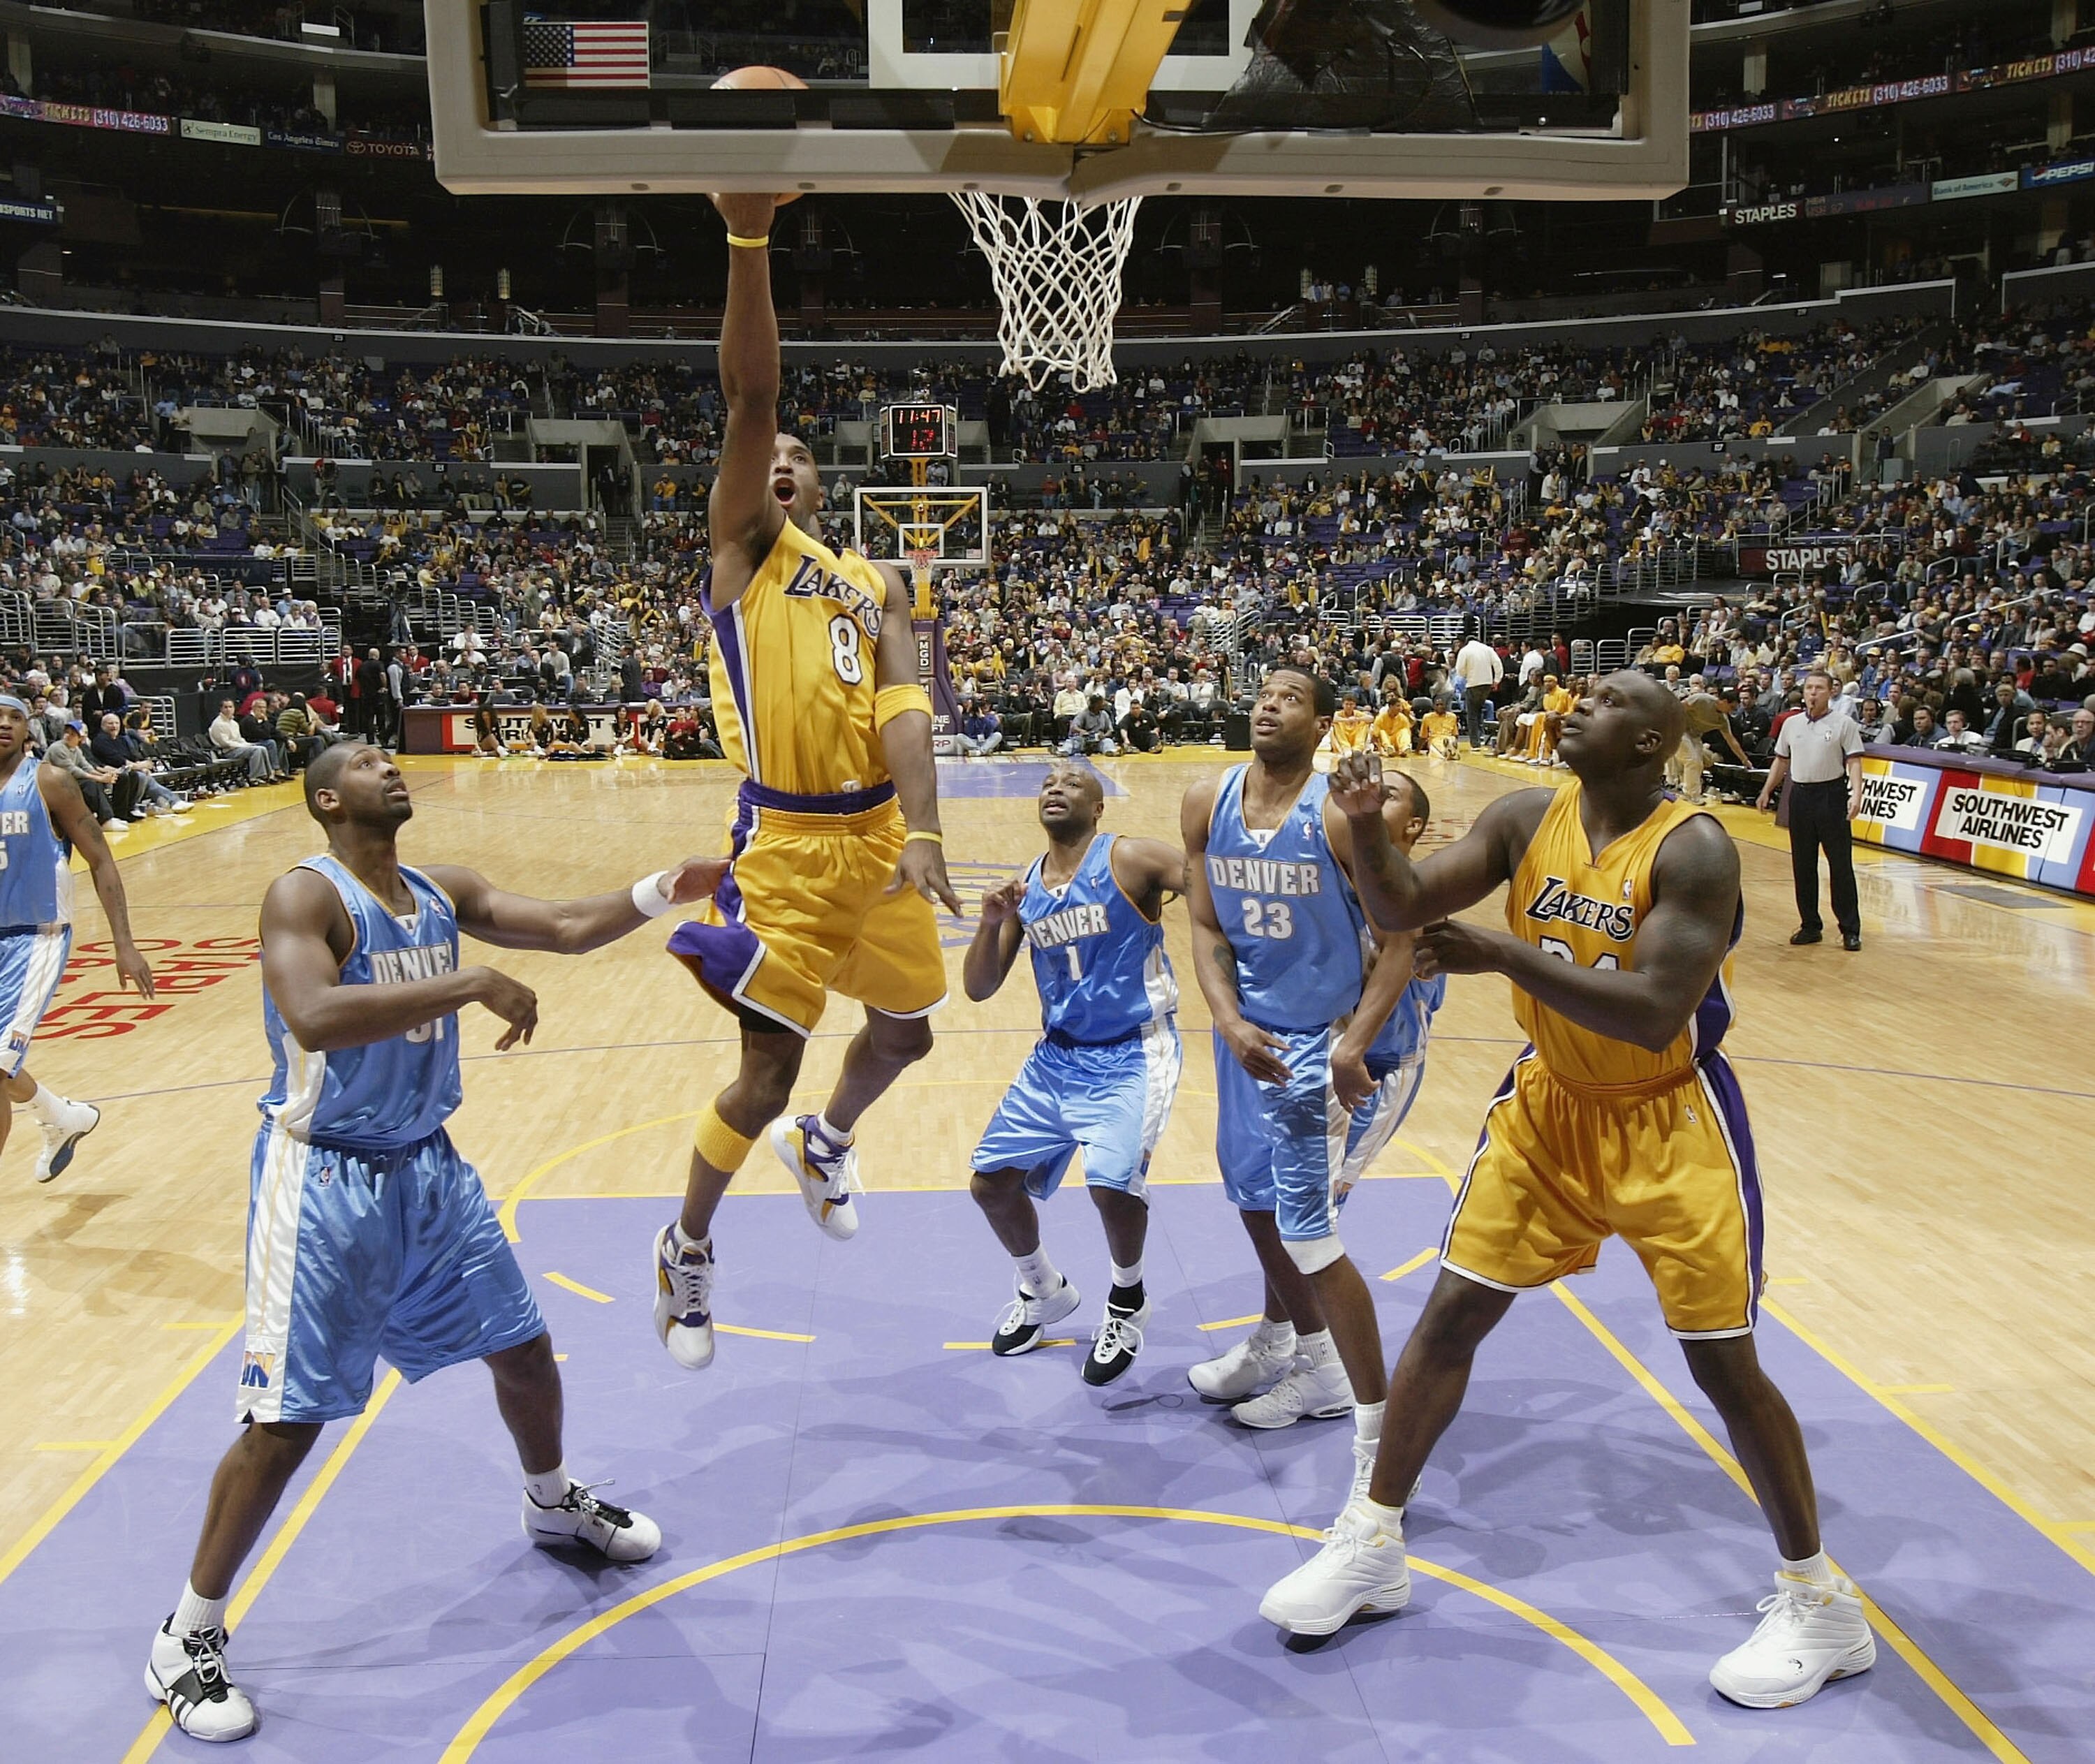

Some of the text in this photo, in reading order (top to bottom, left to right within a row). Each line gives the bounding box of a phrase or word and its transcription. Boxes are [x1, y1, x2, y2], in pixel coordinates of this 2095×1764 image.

[1828, 88, 1871, 108] TICKETS
[367, 142, 419, 156] TOYOTA
[2046, 161, 2095, 180] PEPSI
[1934, 186, 1952, 196] Bank
[1962, 182, 1994, 191] America
[1735, 203, 1797, 224] STAPLES
[899, 409, 941, 424] 11:47
[784, 554, 882, 638] LAKERS
[829, 614, 863, 686] 8
[1860, 778, 1918, 803] HWEST
[1860, 798, 1898, 819] INES
[1953, 793, 2070, 832] SOUTHWEST
[1960, 816, 2045, 849] AIRLINES
[1207, 856, 1320, 895] DENVER
[1241, 899, 1293, 940] 23
[1524, 876, 1635, 942] LAKERS
[370, 942, 454, 984] DENVE
[1066, 945, 1082, 981] 1
